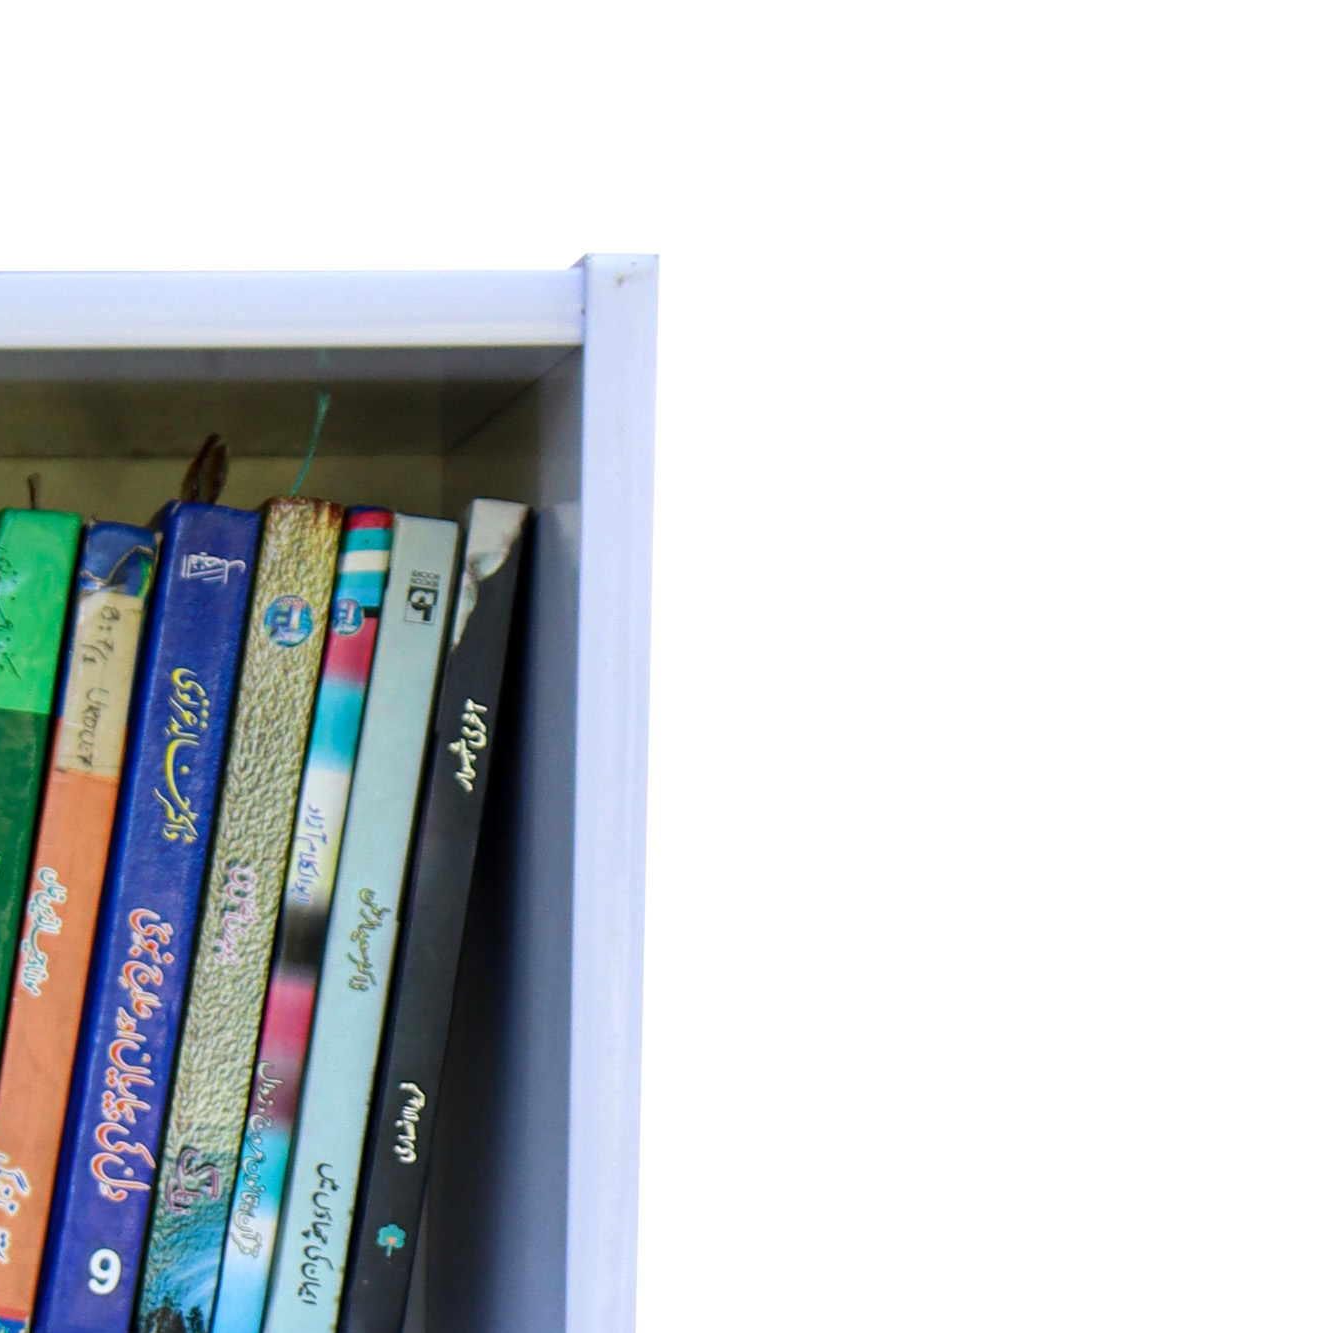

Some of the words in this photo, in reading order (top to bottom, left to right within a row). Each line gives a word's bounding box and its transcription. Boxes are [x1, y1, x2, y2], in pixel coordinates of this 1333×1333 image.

[169, 667, 210, 729] غزنوی
[456, 698, 488, 748] آخری
[154, 716, 207, 814] خالد
[448, 738, 481, 792] شہسوار
[154, 788, 199, 844] ڈاکٹر
[117, 960, 164, 1020] علاج
[115, 1006, 148, 1042] اور
[101, 1037, 153, 1124] بیماریاں
[256, 1061, 283, 1106] زوال
[92, 1121, 158, 1168] کی
[241, 1113, 271, 1161] عروج
[90, 1152, 152, 1203] دل
[165, 1145, 218, 1215] زندگی
[237, 1155, 266, 1205] قانون
[315, 1162, 340, 1191] میں
[228, 1209, 262, 1258] قرآن
[302, 1244, 334, 1270] کی
[88, 1248, 121, 1294] 6
[297, 1261, 321, 1305] ایمان
